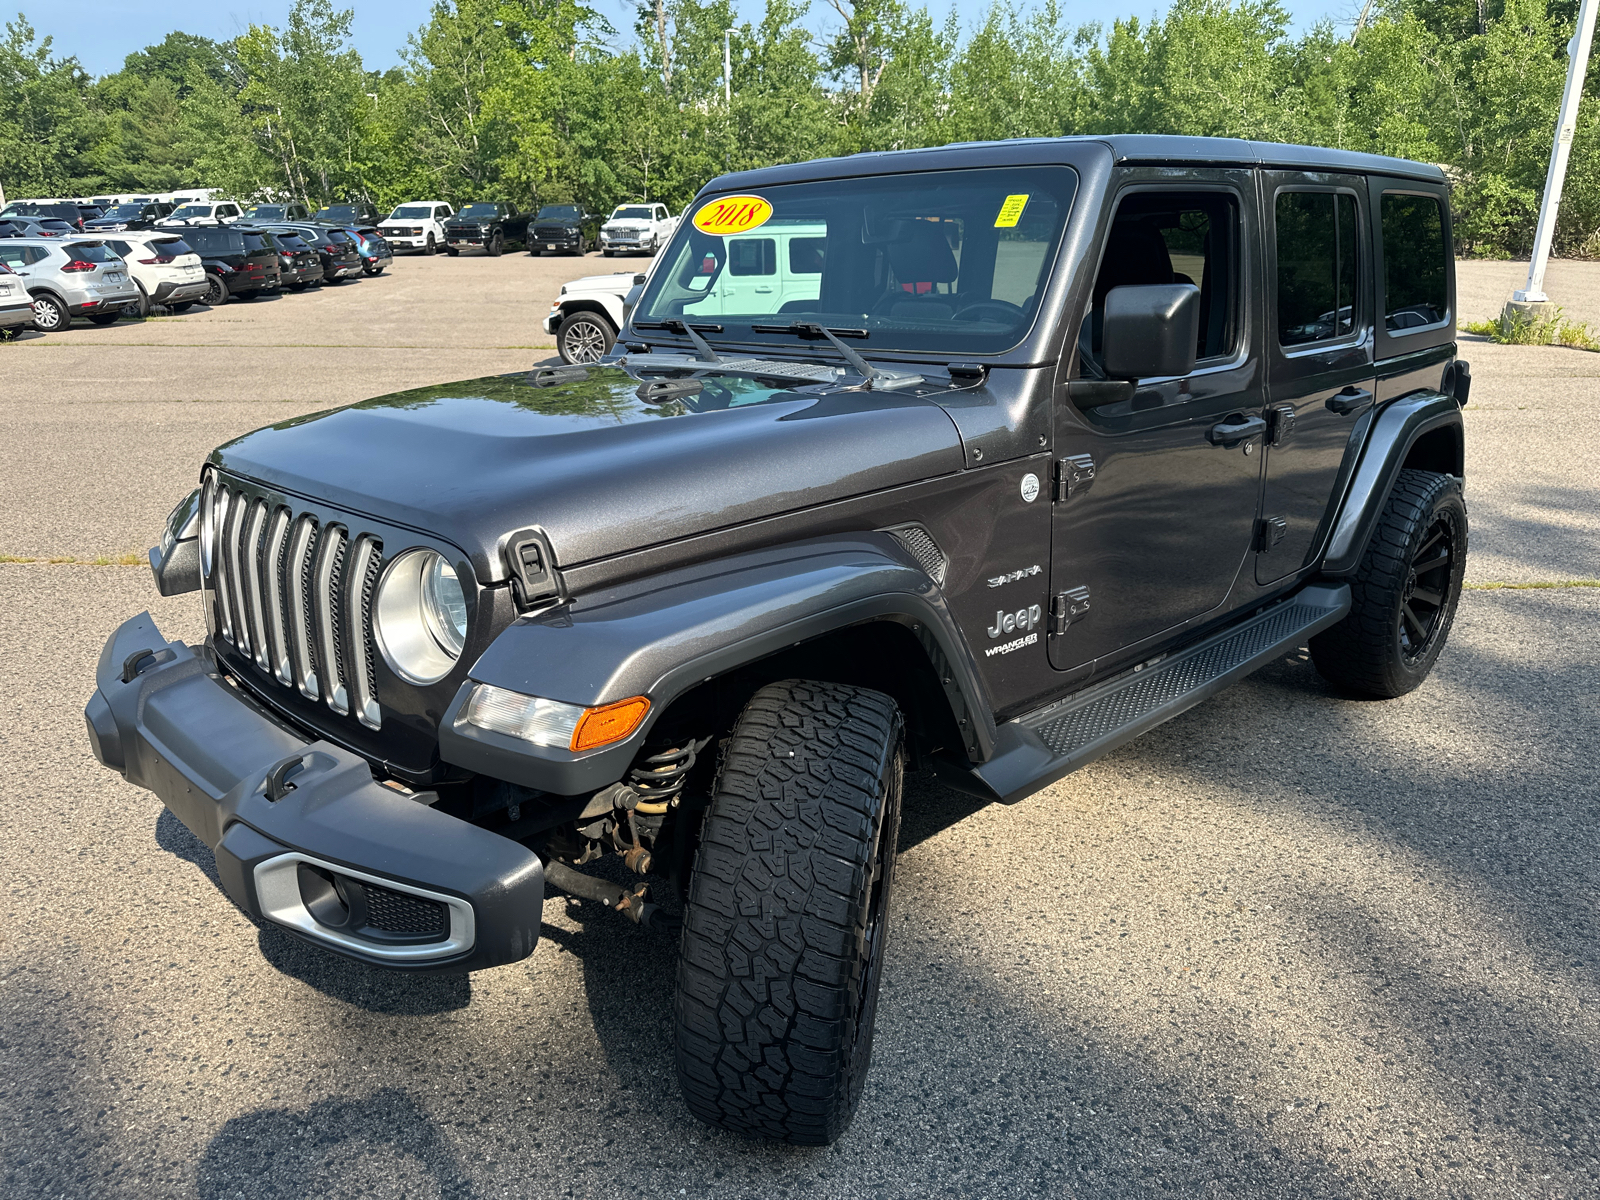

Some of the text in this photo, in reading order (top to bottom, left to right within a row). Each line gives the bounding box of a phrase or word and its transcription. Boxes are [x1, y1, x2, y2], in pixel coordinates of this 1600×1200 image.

[701, 203, 762, 226] 2018
[987, 565, 1042, 588] SAHARA
[987, 604, 1041, 638] Jeep
[985, 632, 1038, 657] WRANGLER
